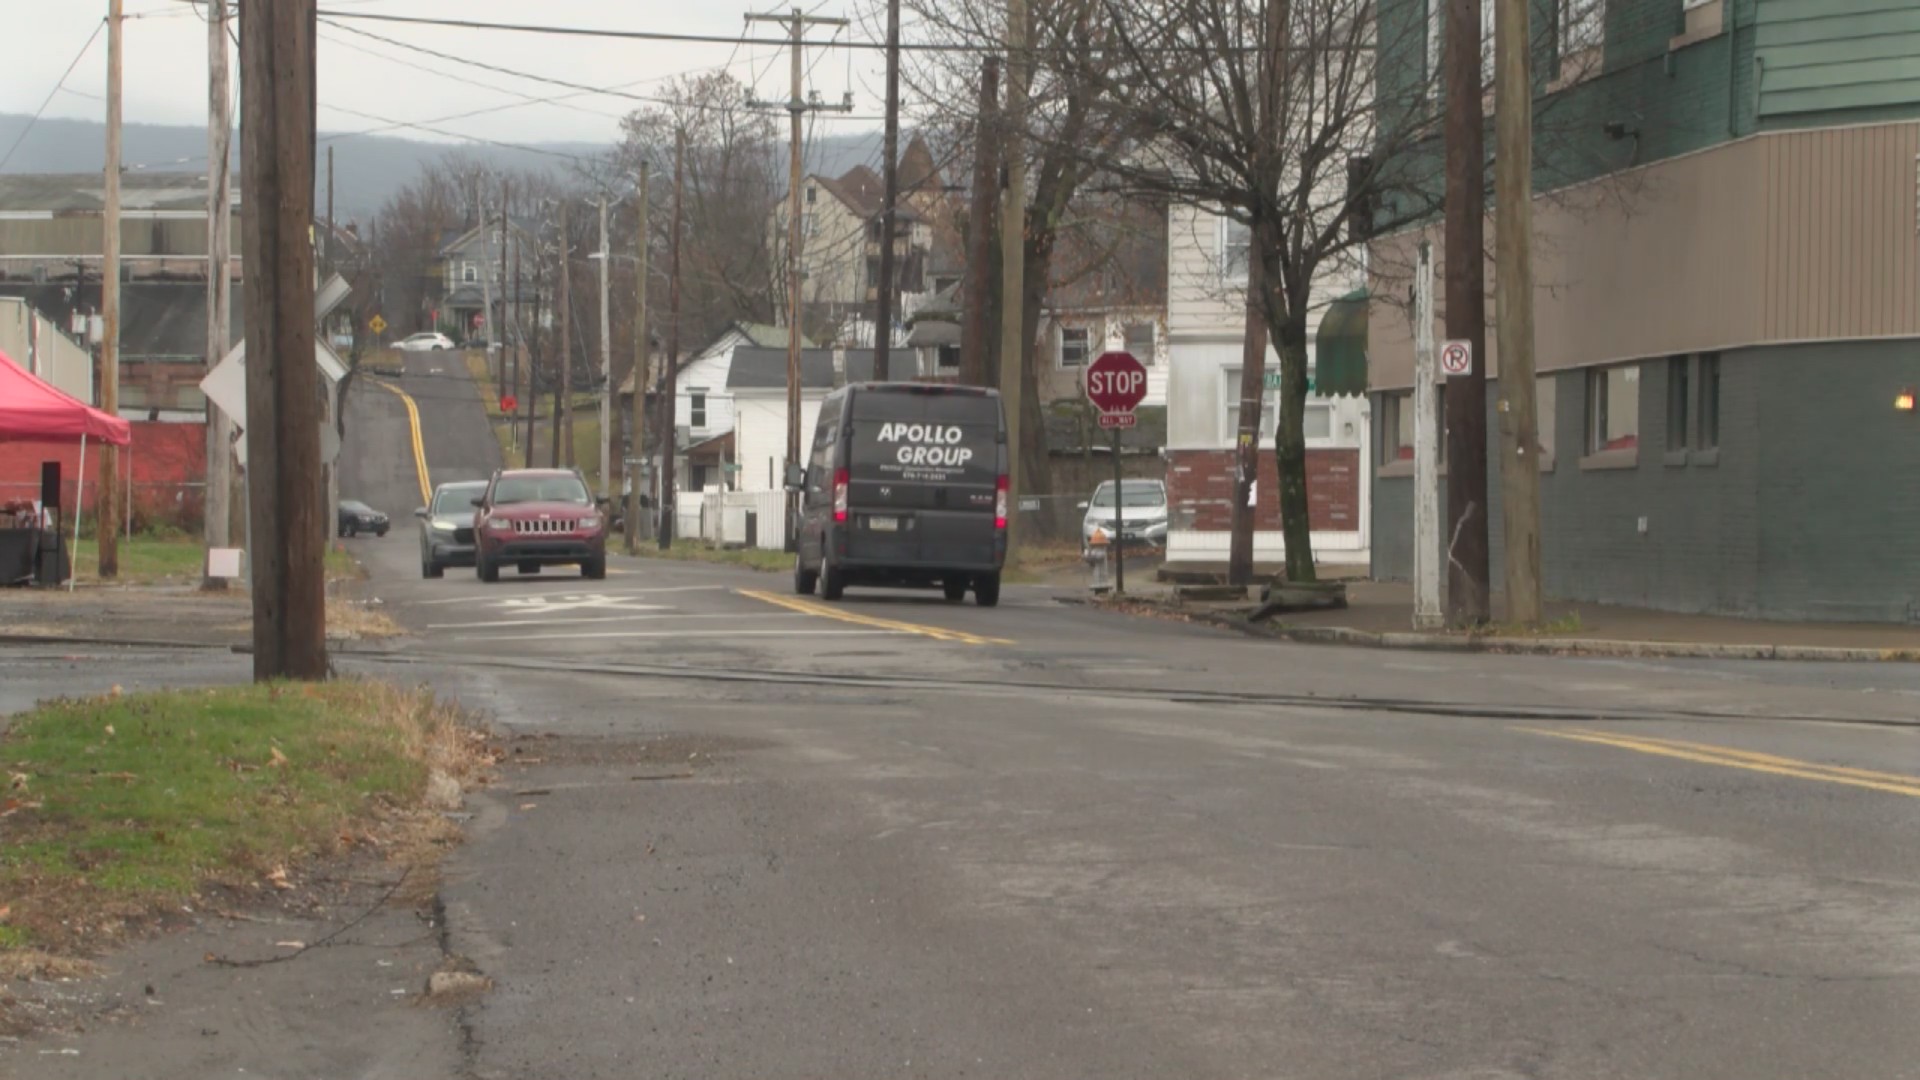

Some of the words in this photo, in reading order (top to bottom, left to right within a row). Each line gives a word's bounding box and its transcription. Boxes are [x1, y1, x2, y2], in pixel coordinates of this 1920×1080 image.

[1090, 371, 1143, 394] STOP
[877, 422, 962, 444] APOLLO
[897, 446, 973, 466] GROUP
